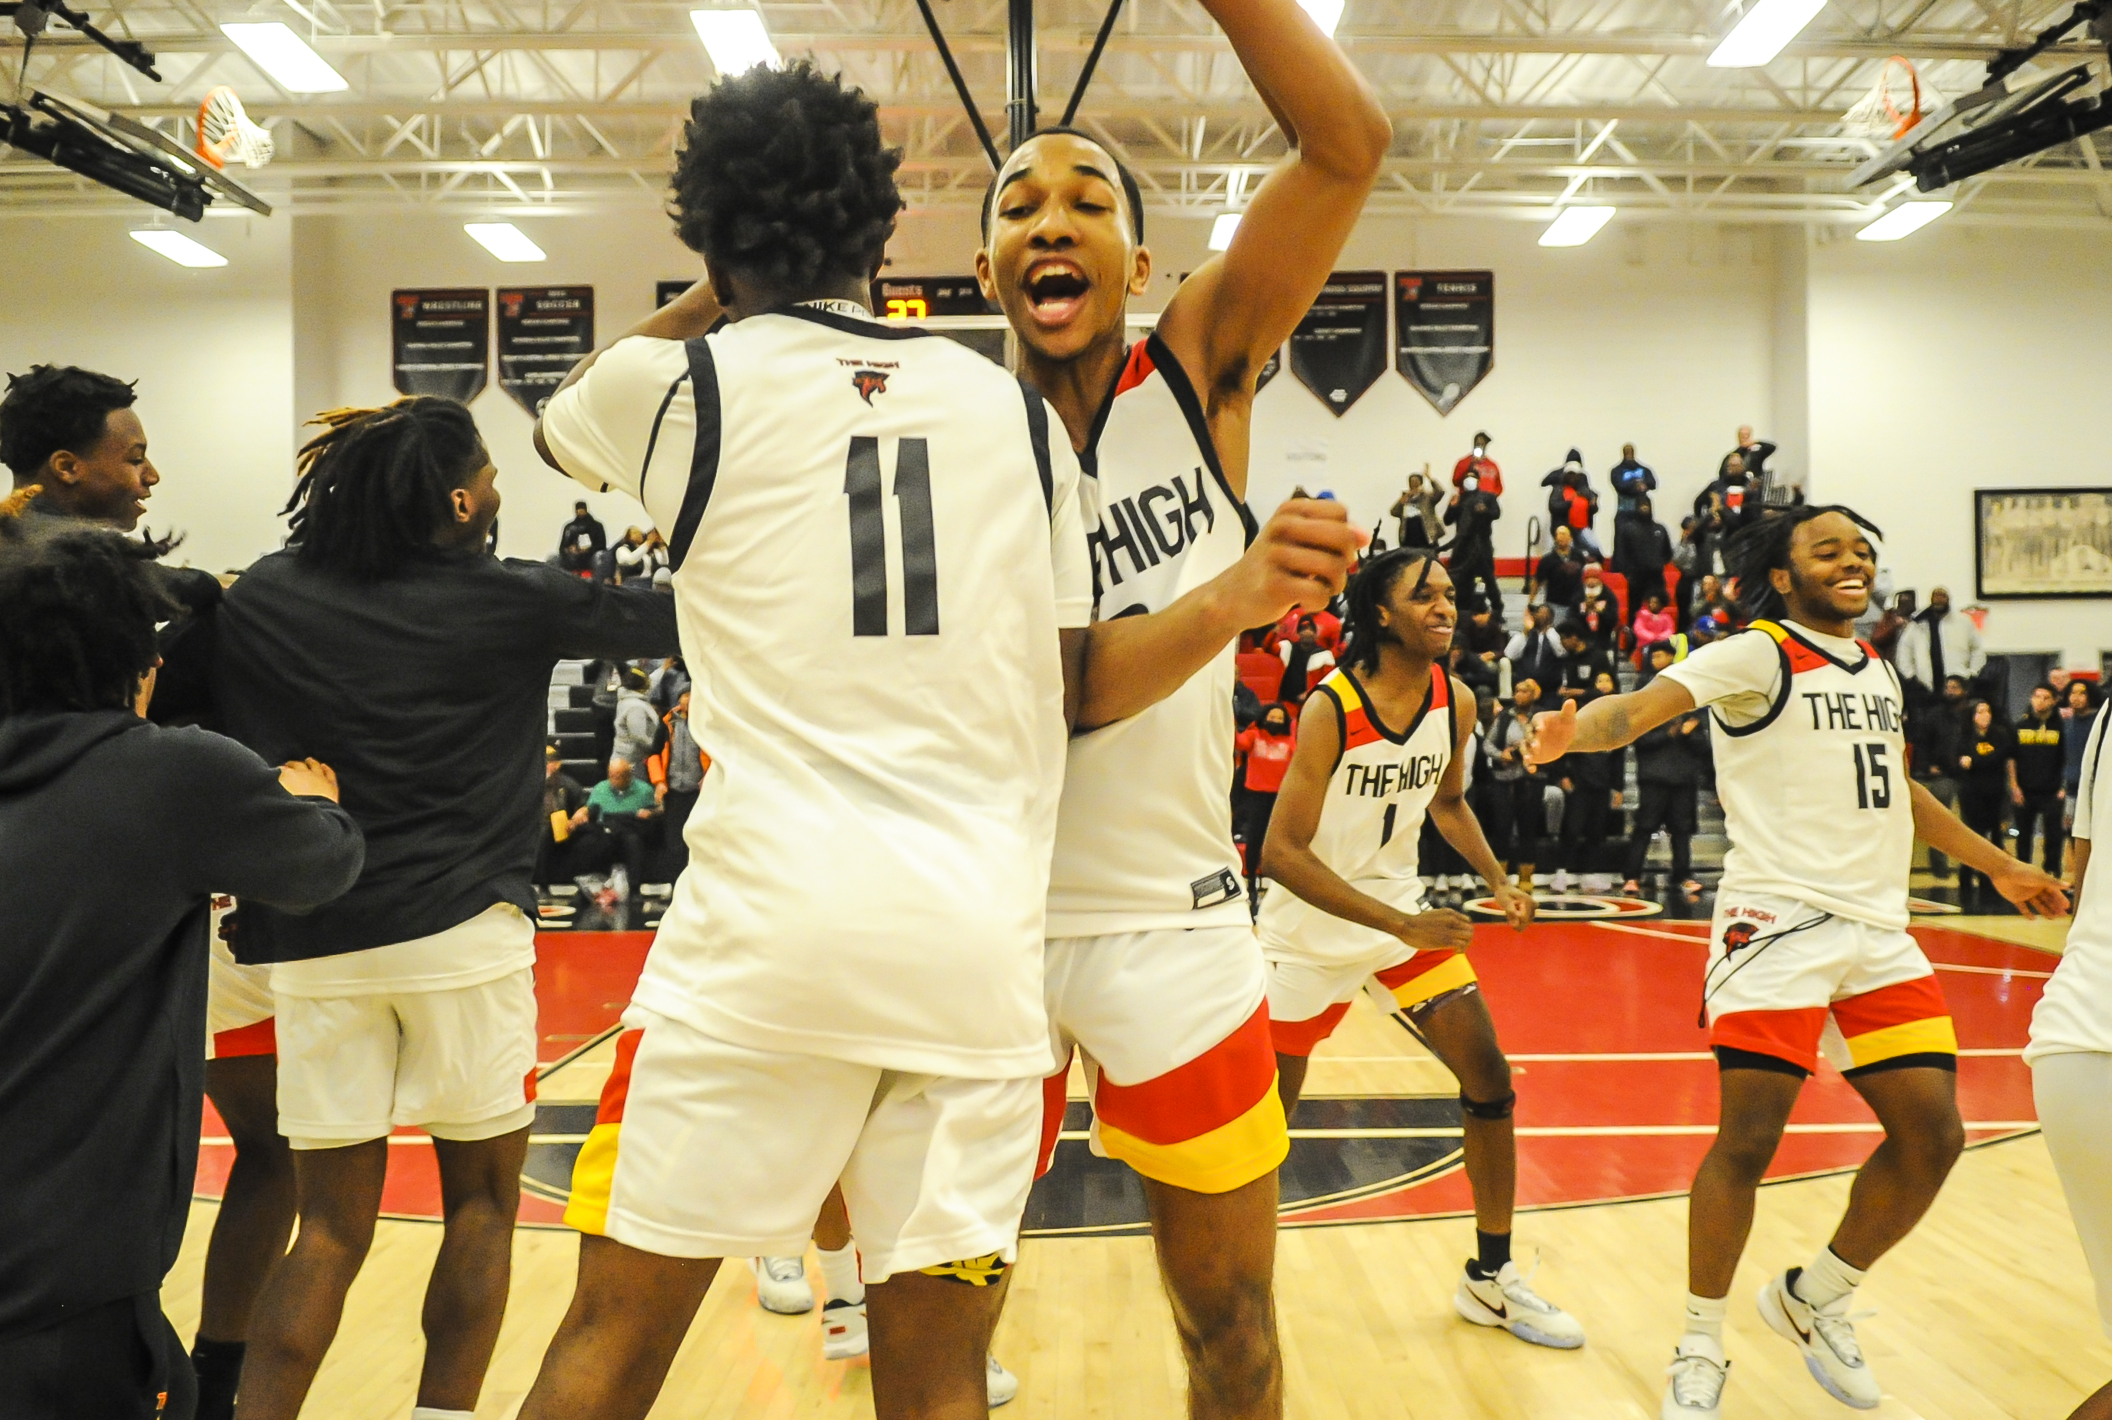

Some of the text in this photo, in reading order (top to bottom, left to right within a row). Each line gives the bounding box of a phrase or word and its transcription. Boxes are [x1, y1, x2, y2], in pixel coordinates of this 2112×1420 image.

[843, 435, 940, 637] 11
[1802, 692, 1900, 732] THE HIG
[1345, 752, 1443, 798] THE HIGH
[1853, 743, 1890, 809] 15
[1380, 803, 1398, 850] 1
